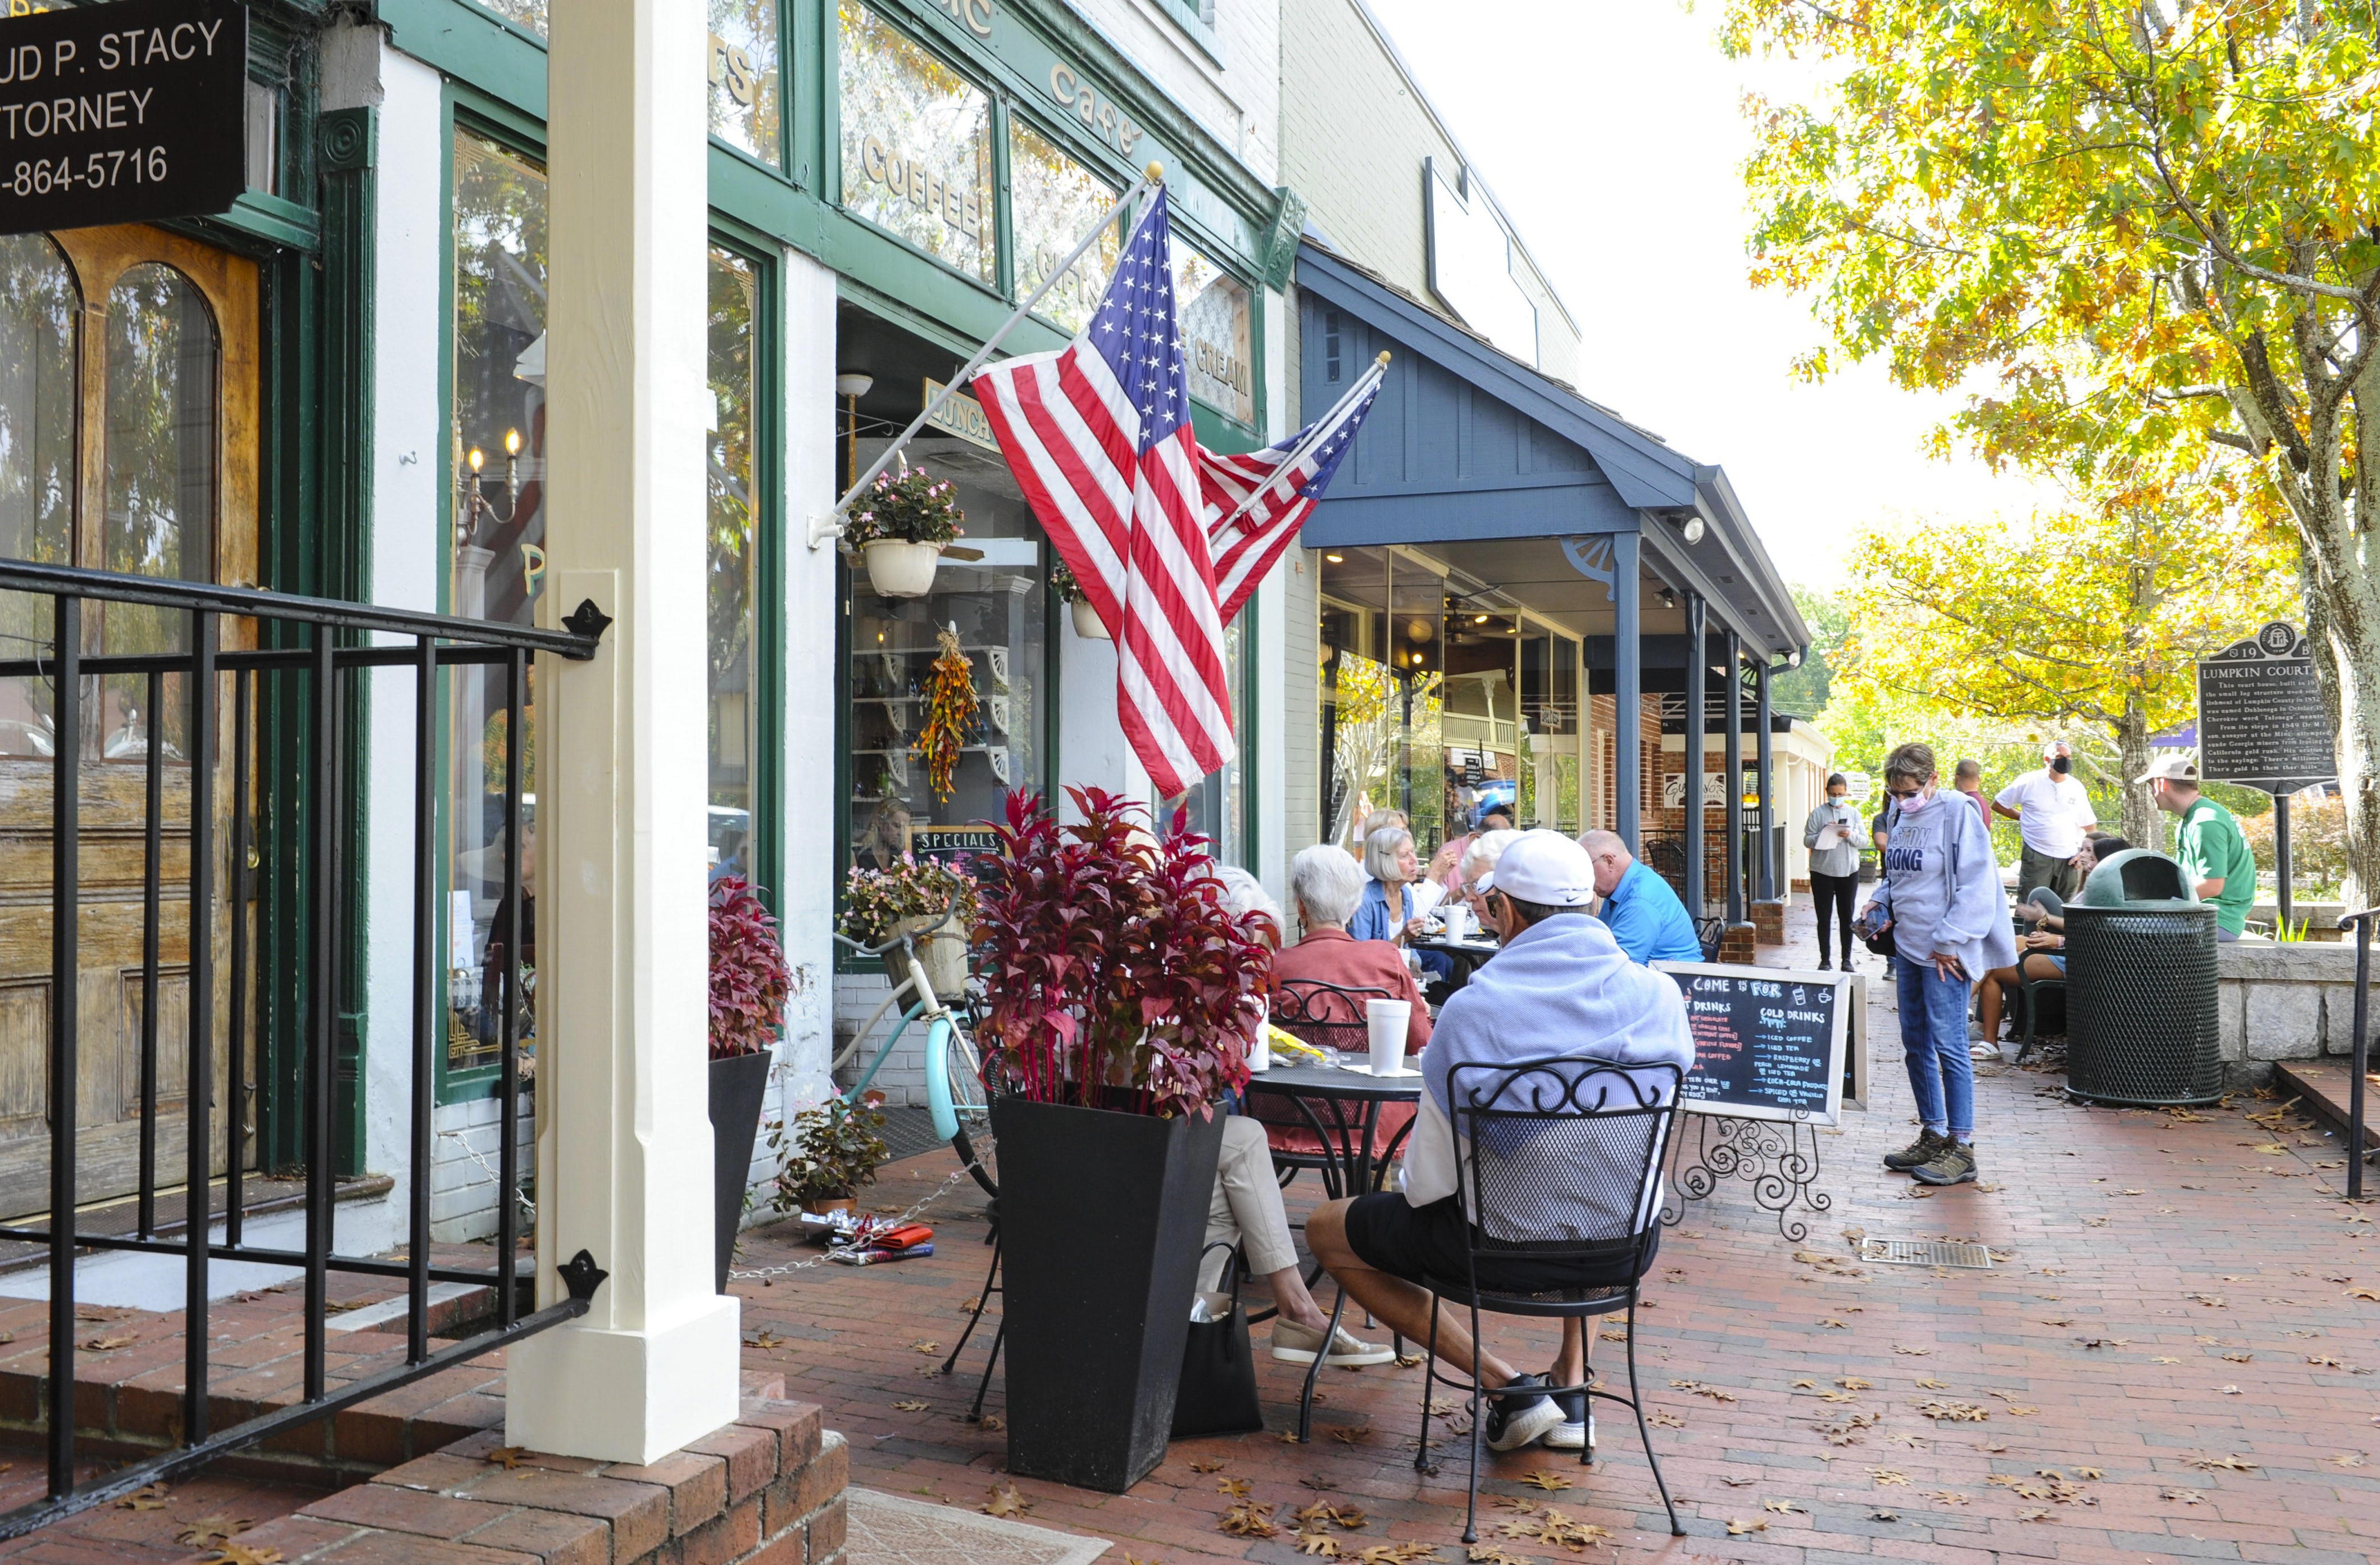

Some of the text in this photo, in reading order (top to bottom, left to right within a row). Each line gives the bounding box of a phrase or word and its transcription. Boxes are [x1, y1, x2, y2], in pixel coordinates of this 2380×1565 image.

[55, 40, 85, 76] P.
[99, 19, 222, 70] STACY
[0, 88, 153, 139] TORNEY
[862, 134, 978, 240] COFFEE
[1195, 337, 1248, 397] CREAM
[931, 390, 991, 442] LUNCH
[2242, 647, 2257, 659] 19
[2203, 665, 2311, 679] LUMPKIN COURT
[922, 833, 996, 847] SPECIALS
[1890, 827, 1932, 849] STON
[1887, 849, 1923, 872] RONG
[1693, 977, 1731, 992] COME
[1750, 981, 1782, 997] FOR
[1693, 1001, 1731, 1013] DRINKS
[1760, 1008, 1825, 1023] COLD DRINKS
[1773, 1054, 1810, 1065] RASPBERRY
[1777, 1063, 1810, 1072] LEMONADE
[1767, 1077, 1801, 1086] COCA-COLA
[1764, 1087, 1788, 1096] SPICED
[1798, 1090, 1824, 1099] VANILLA
